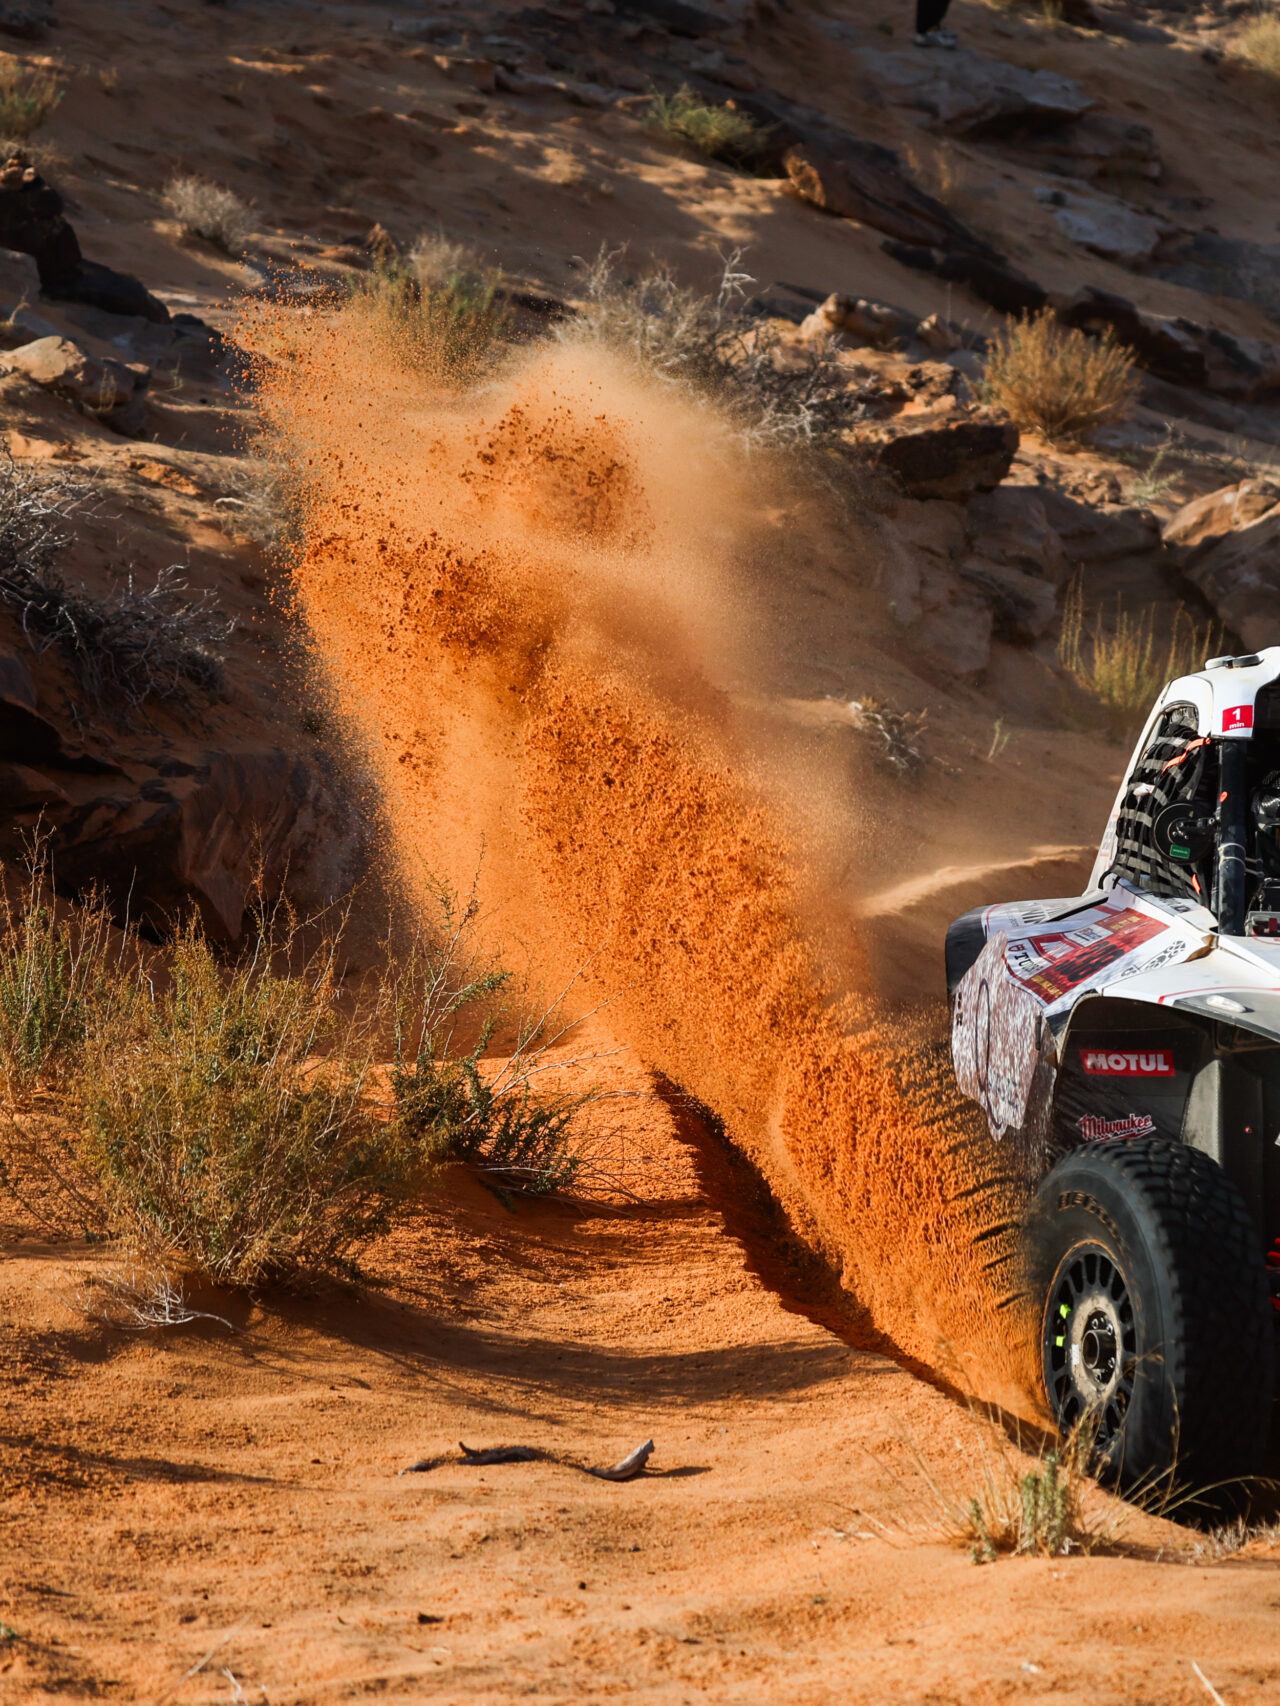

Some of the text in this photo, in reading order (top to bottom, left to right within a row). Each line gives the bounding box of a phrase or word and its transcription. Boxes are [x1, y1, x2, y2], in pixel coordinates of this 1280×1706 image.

[1232, 708, 1241, 721] 1
[1086, 1053, 1169, 1071] MOTUL
[1076, 1113, 1155, 1141] Milwaukee
